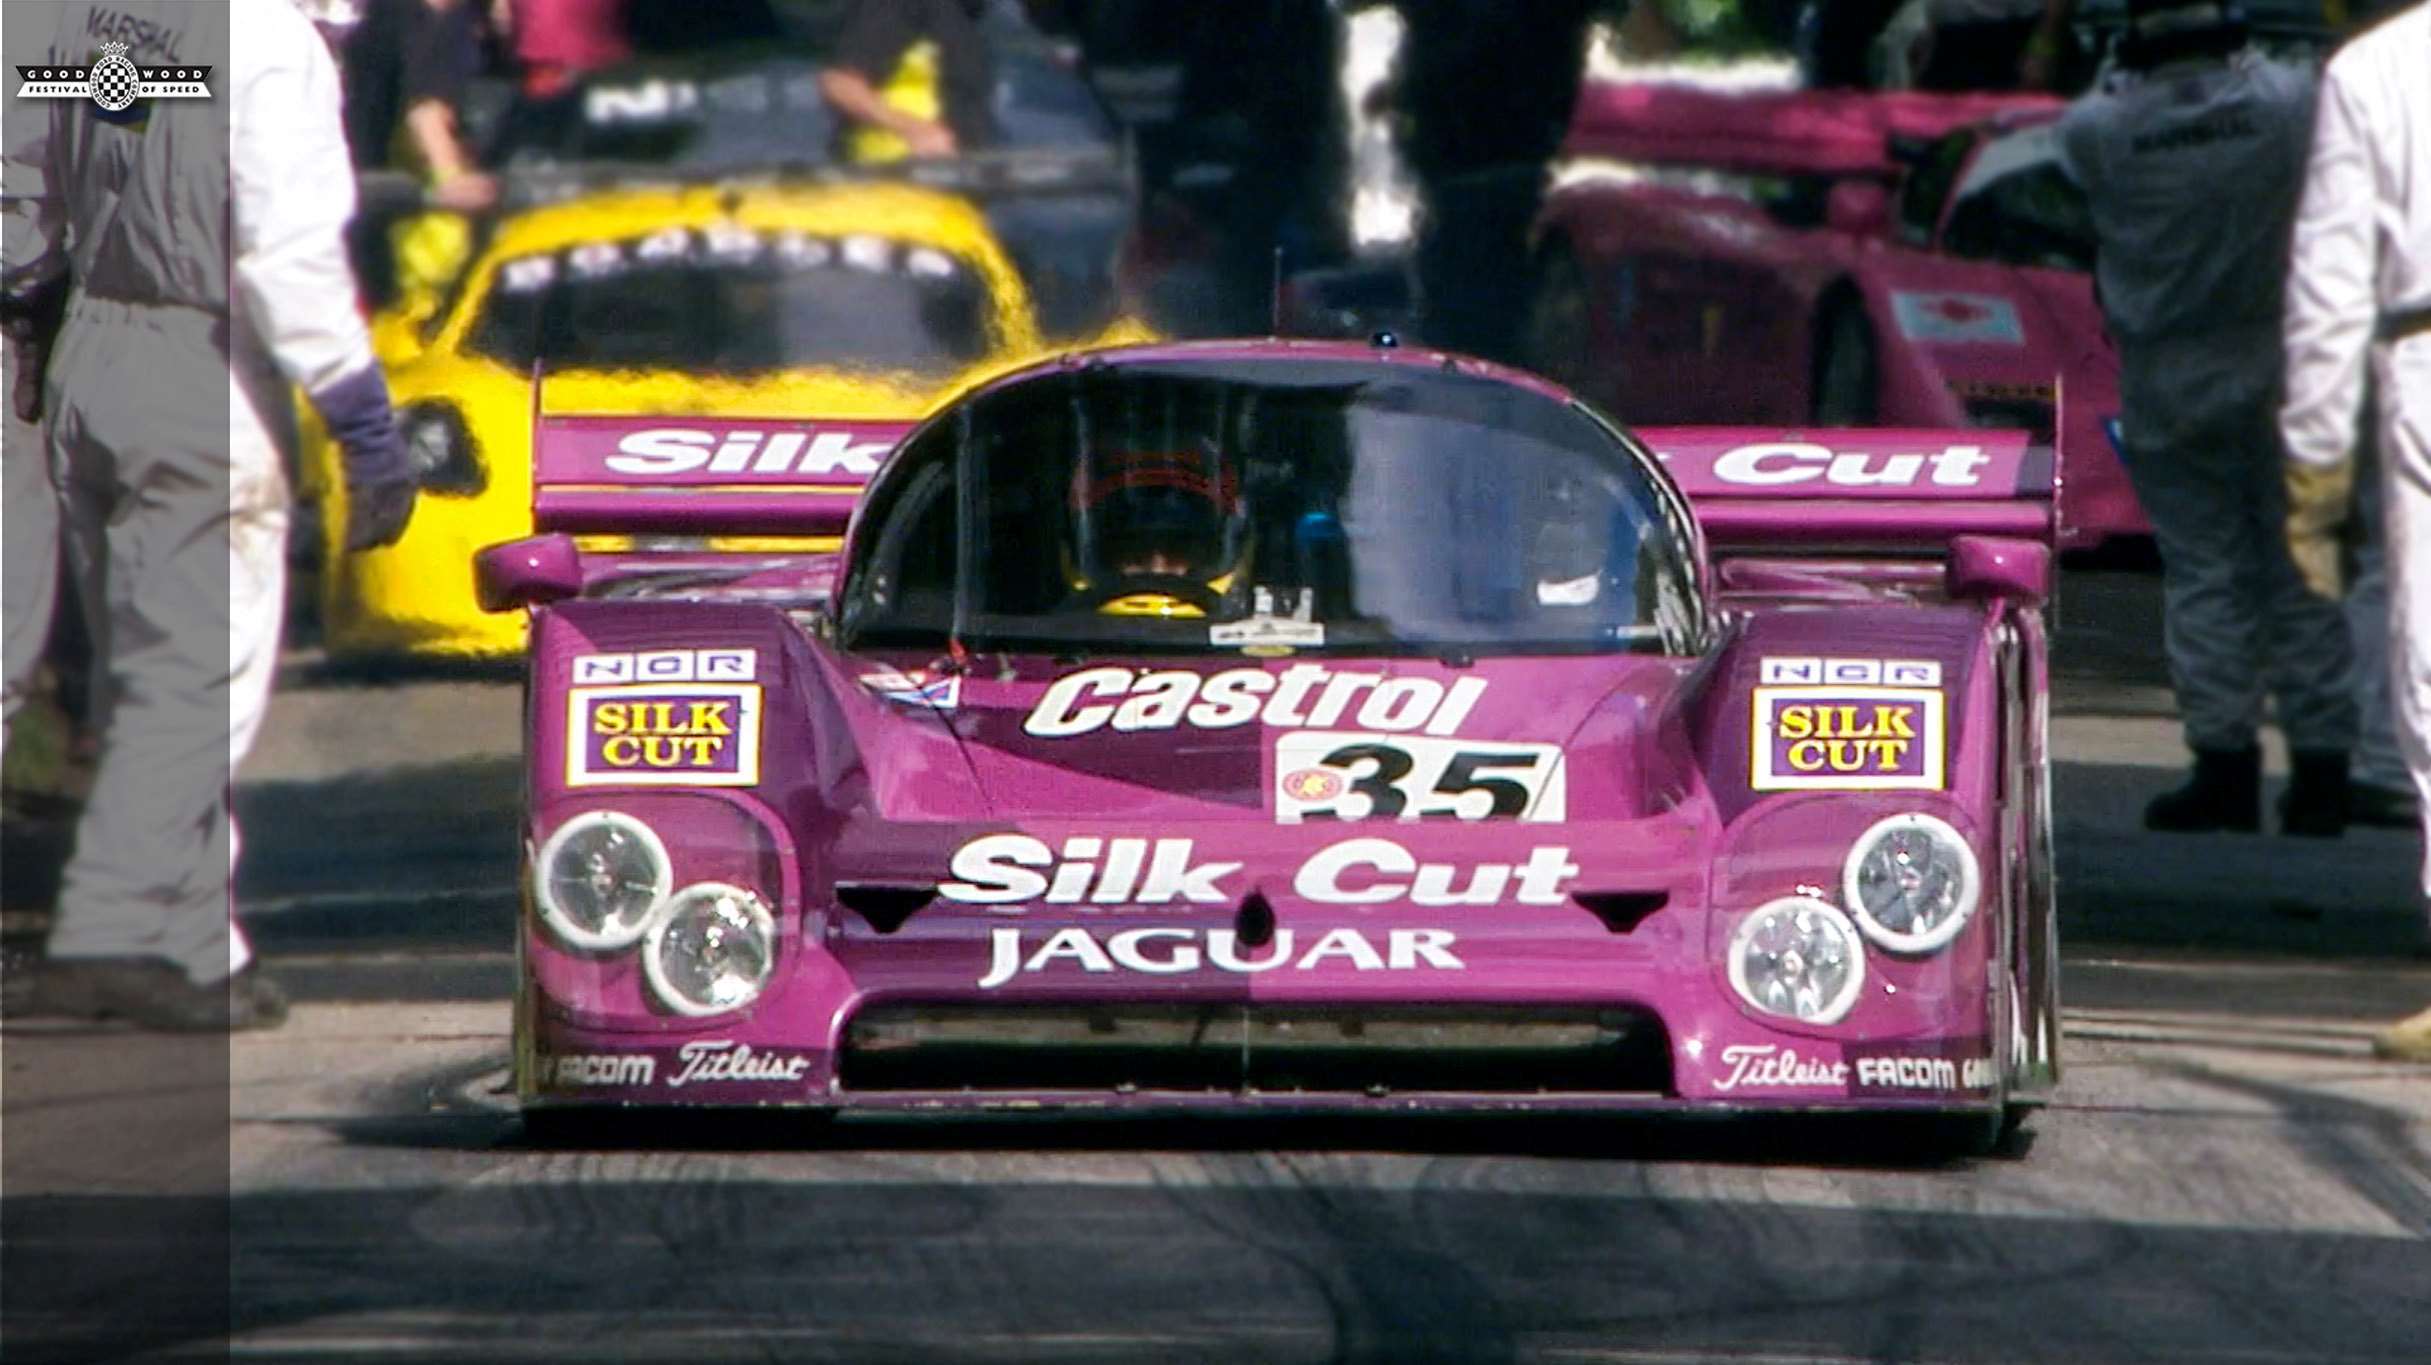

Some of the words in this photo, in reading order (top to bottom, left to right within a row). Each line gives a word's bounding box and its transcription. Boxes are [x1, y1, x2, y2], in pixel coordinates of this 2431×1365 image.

[605, 429, 894, 474] Silk
[1713, 442, 1990, 486] Cut
[593, 701, 733, 736] SILK
[1024, 663, 1487, 737] Castrol
[1779, 705, 1917, 739] SILK
[602, 735, 723, 767] CUT
[1788, 739, 1909, 771] CUT
[1301, 743, 1541, 822] 35
[938, 834, 1245, 903] Silk
[1294, 837, 1580, 906] Cut
[977, 928, 1466, 989] JAGUAR
[666, 1040, 811, 1088] Titleist
[1711, 1044, 1851, 1090] Titleist
[1857, 1057, 1957, 1089] FACOM
